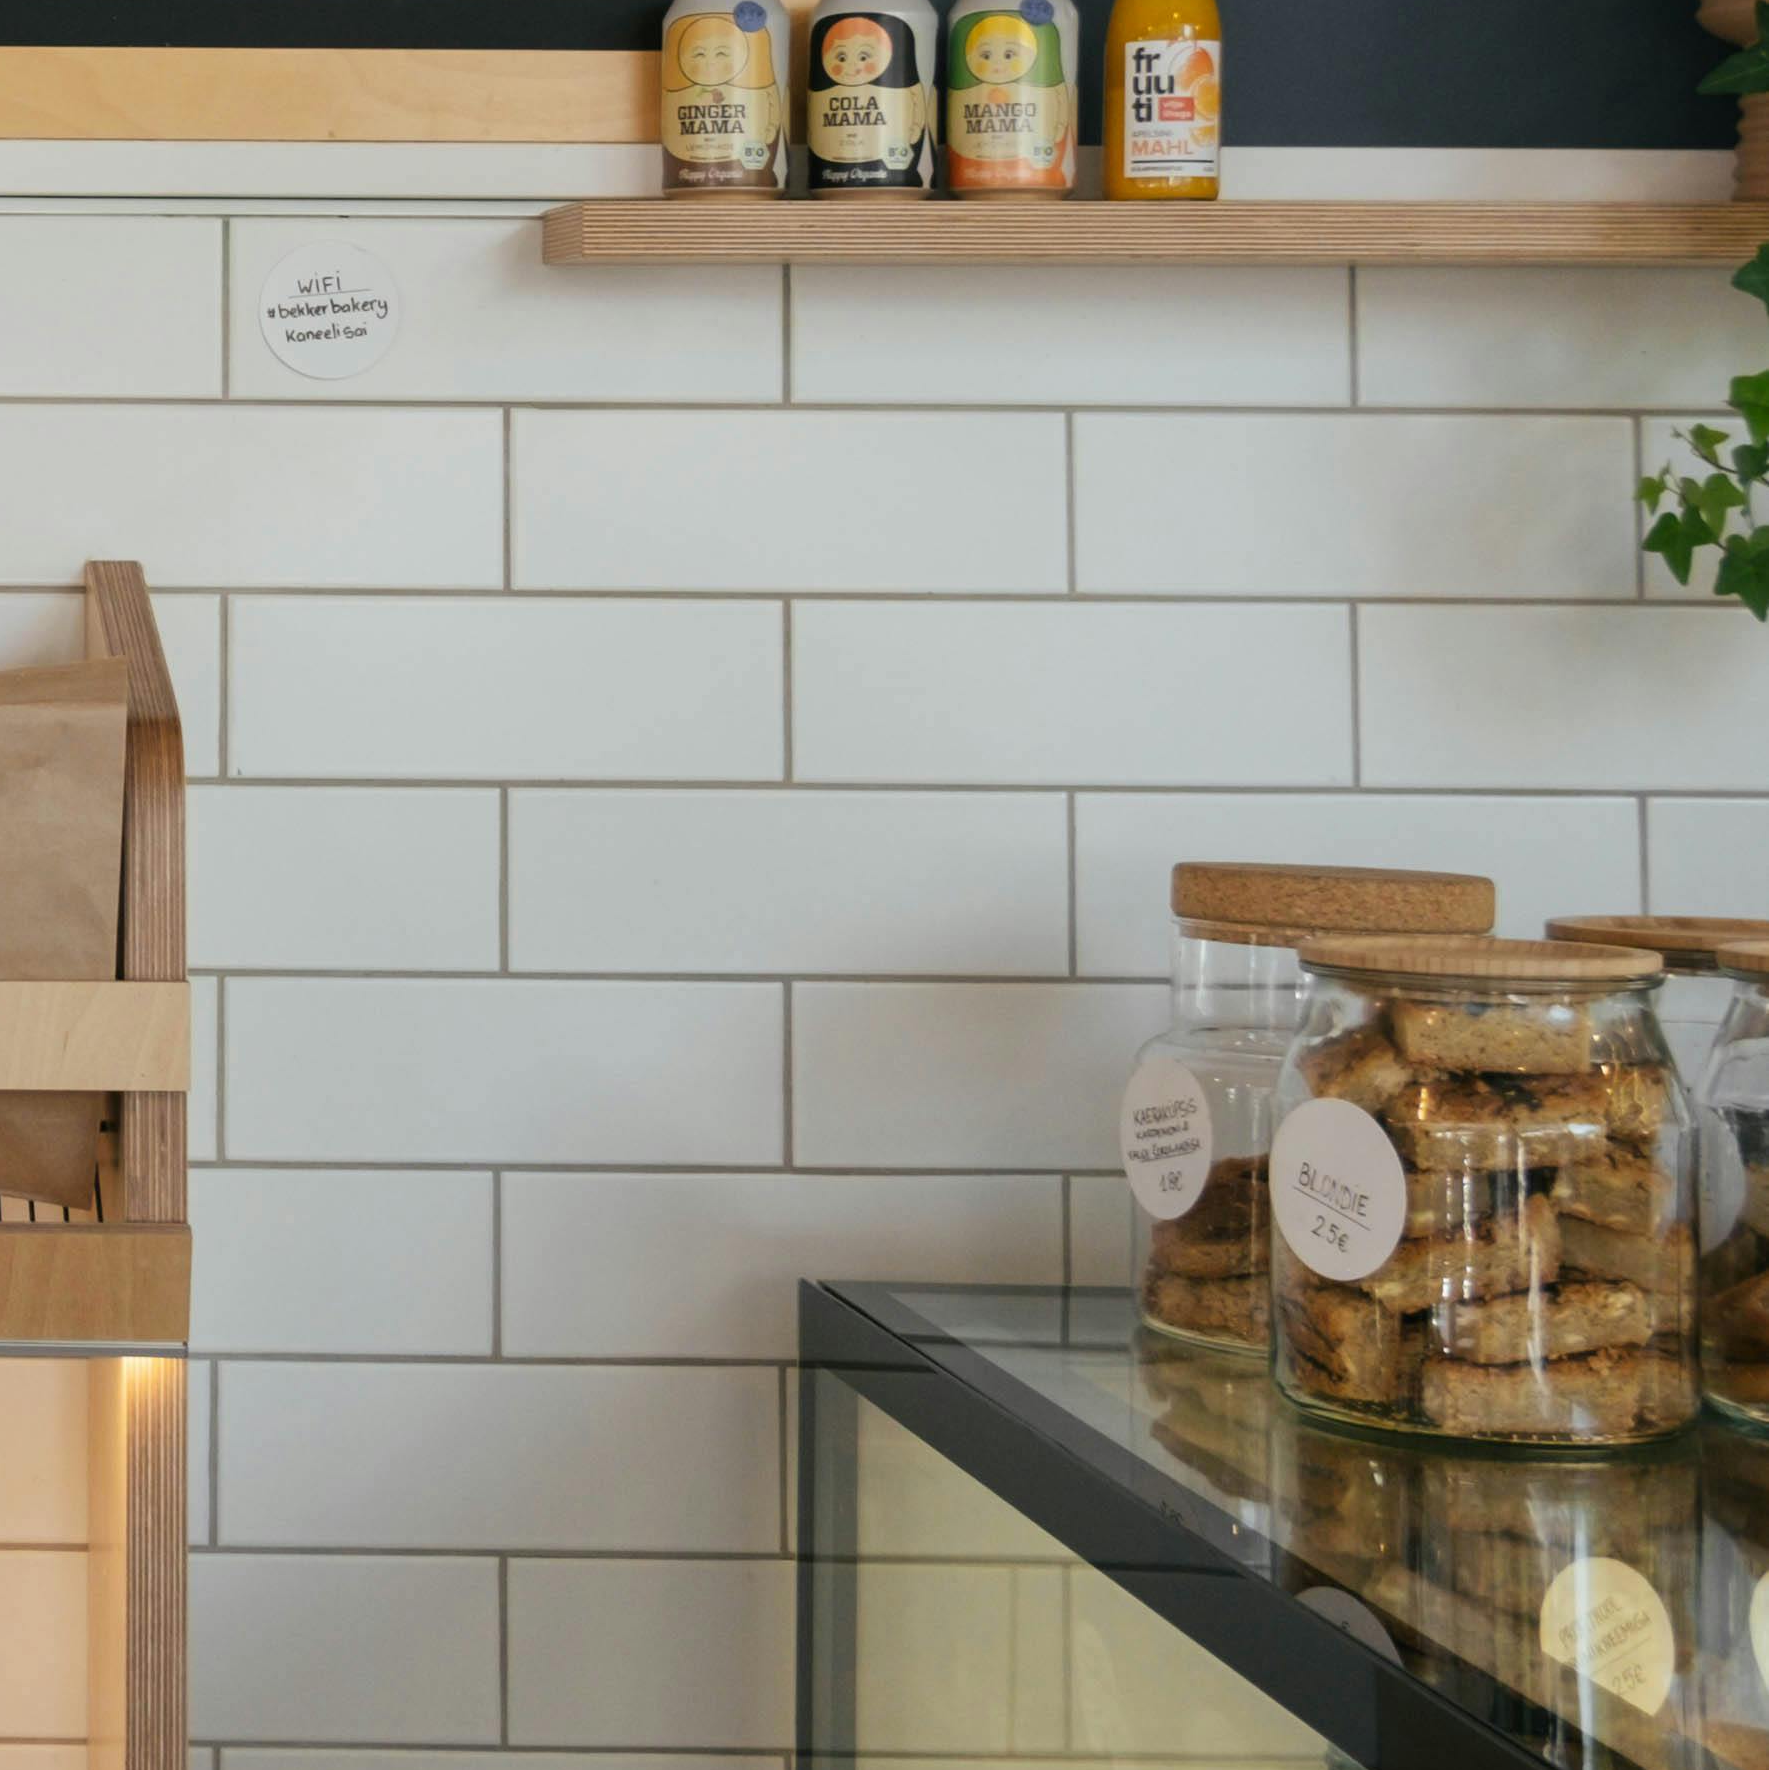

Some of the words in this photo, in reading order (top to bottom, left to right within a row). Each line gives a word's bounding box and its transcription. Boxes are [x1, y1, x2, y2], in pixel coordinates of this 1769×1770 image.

[678, 104, 746, 120] GINGER
[829, 97, 879, 111] COLA
[964, 103, 1037, 119] MANGO
[823, 111, 887, 127] MAMA
[966, 118, 1033, 134] MAMA
[680, 121, 745, 135] MAMA
[1132, 140, 1193, 156] MAHL
